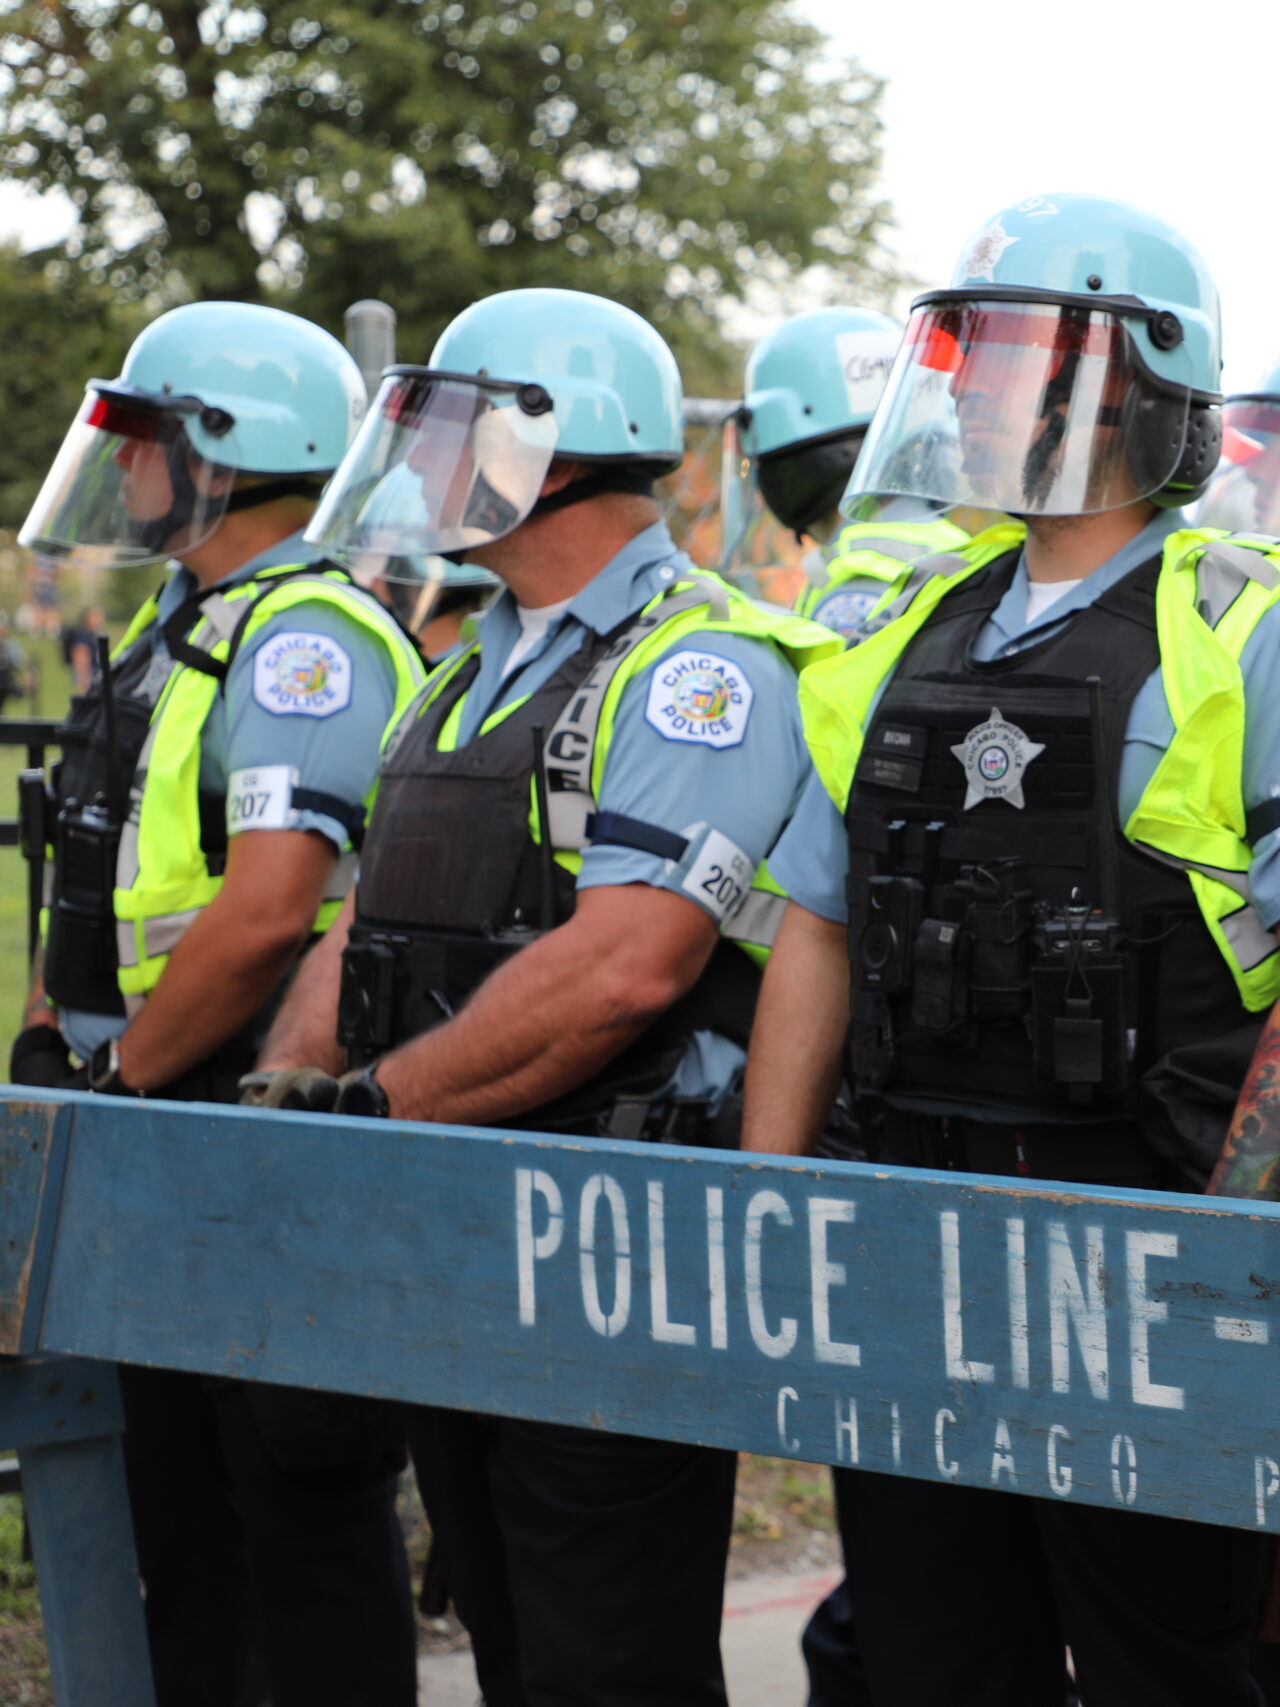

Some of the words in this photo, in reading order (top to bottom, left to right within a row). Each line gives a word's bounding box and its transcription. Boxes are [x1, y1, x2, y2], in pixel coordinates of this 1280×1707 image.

[264, 637, 342, 669] CHICAGO
[266, 683, 336, 707] POLICE
[662, 658, 743, 704] CHICAGO
[661, 704, 734, 736] POLICE
[231, 792, 272, 822] 207
[515, 1168, 862, 1368] POLICE
[776, 1385, 1138, 1505] CHICAGO
